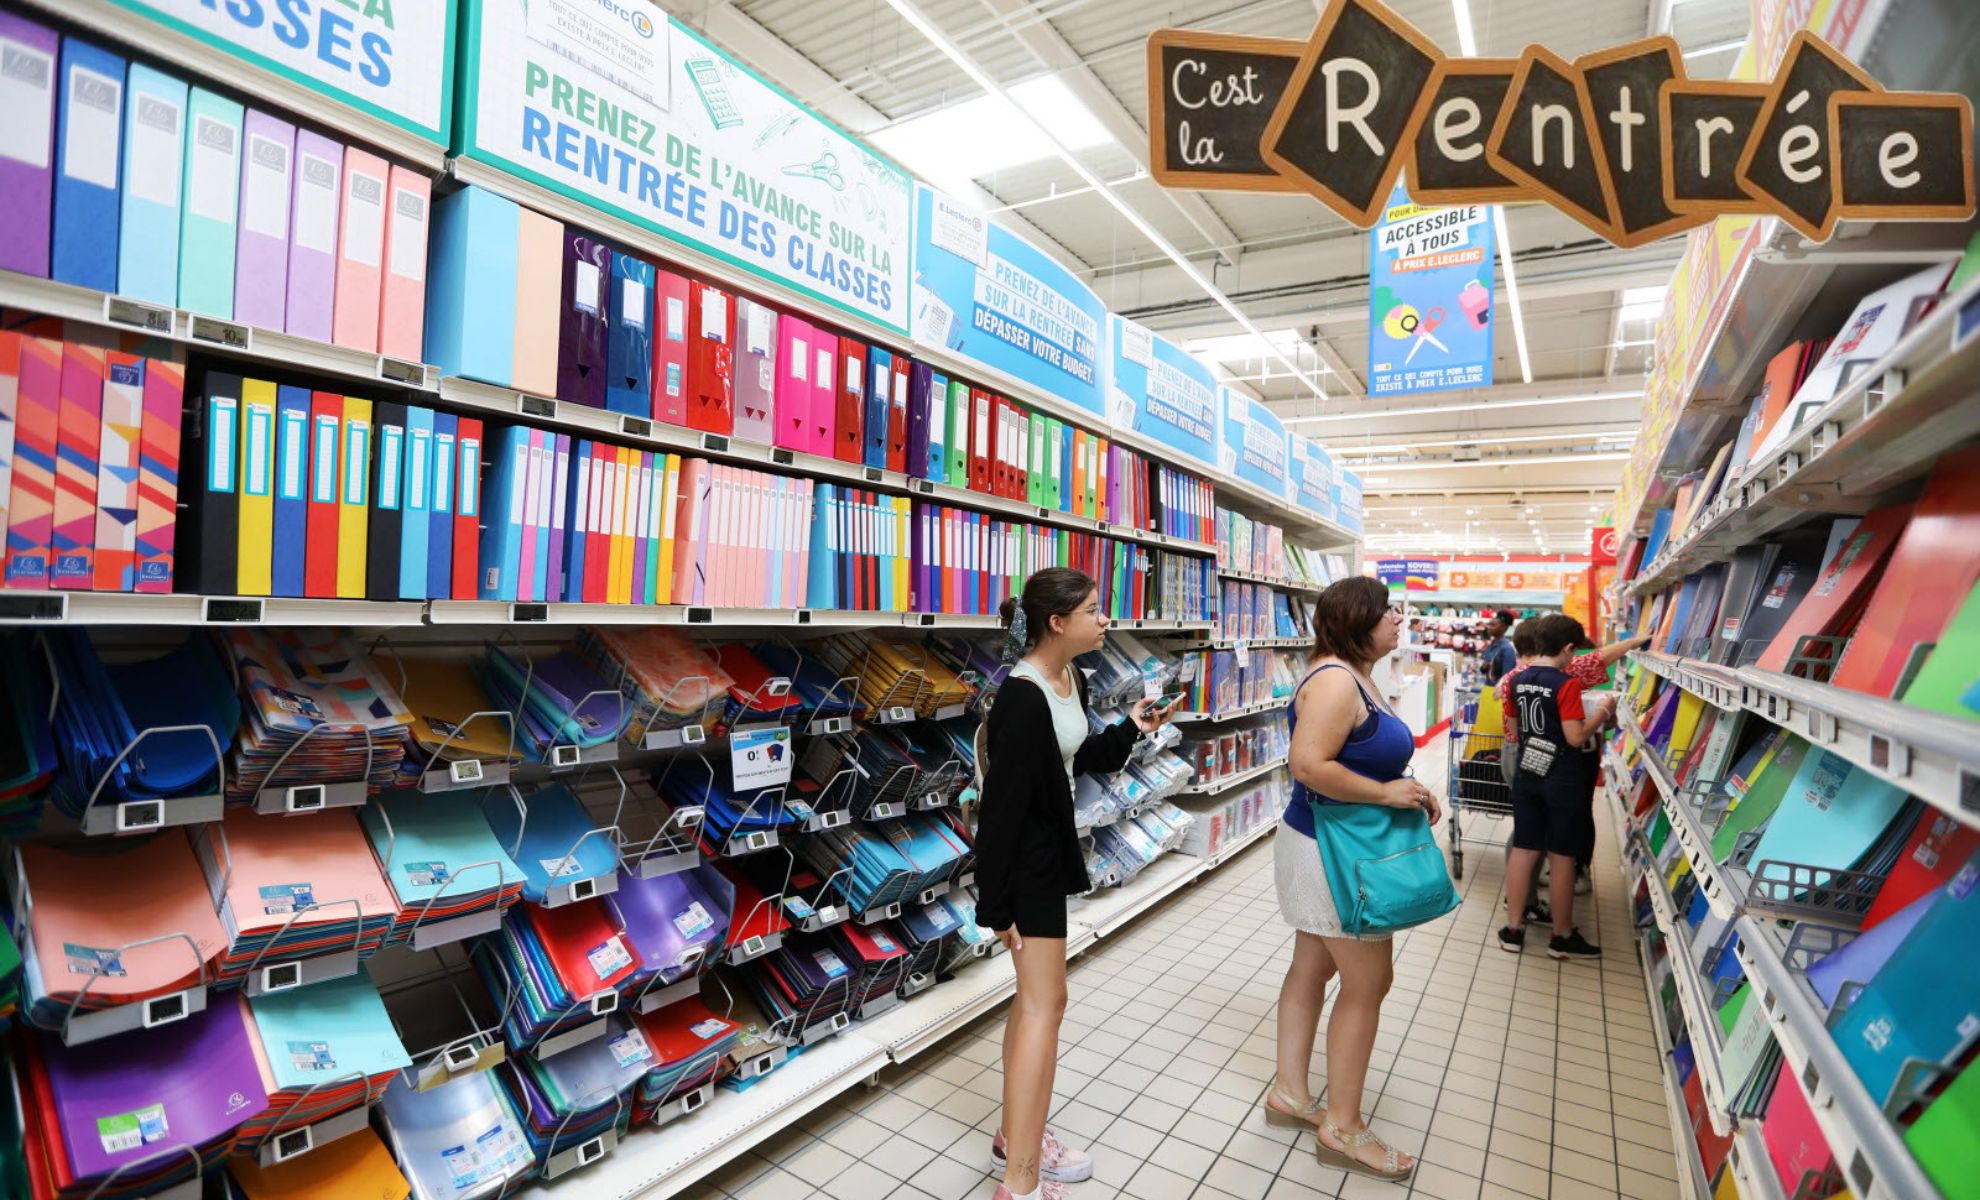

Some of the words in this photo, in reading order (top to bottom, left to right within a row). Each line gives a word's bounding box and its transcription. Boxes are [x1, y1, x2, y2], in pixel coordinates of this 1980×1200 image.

[1172, 58, 1264, 110] C'est
[1179, 120, 1224, 166] la
[1321, 57, 1922, 190] Rentrée
[525, 60, 657, 156] PRENEZ
[666, 134, 702, 176] DE
[710, 158, 822, 241] L'AVANCE
[829, 221, 866, 258] SUR
[871, 245, 893, 277] LA
[522, 105, 707, 229] RENTRÉE
[718, 203, 776, 258] DES
[787, 239, 893, 313] CLASSES
[1385, 205, 1478, 244] ACCESSIBLE
[1388, 206, 1411, 220] POUR
[1403, 257, 1425, 270] PRIX
[1428, 250, 1481, 267] E.LECLERC
[1405, 240, 1416, 257] À
[1421, 229, 1460, 252] TOUS
[995, 261, 1039, 301] PRENEZ
[1042, 289, 1056, 311] DE
[974, 308, 1030, 351] DÉPASSER
[1032, 336, 1062, 366] VOTRE
[985, 284, 1009, 313] SUR
[1012, 298, 1026, 321] LA
[1030, 305, 1072, 350] RENTRÉE
[1076, 336, 1095, 361] SANS
[1516, 696, 1545, 735] 10
